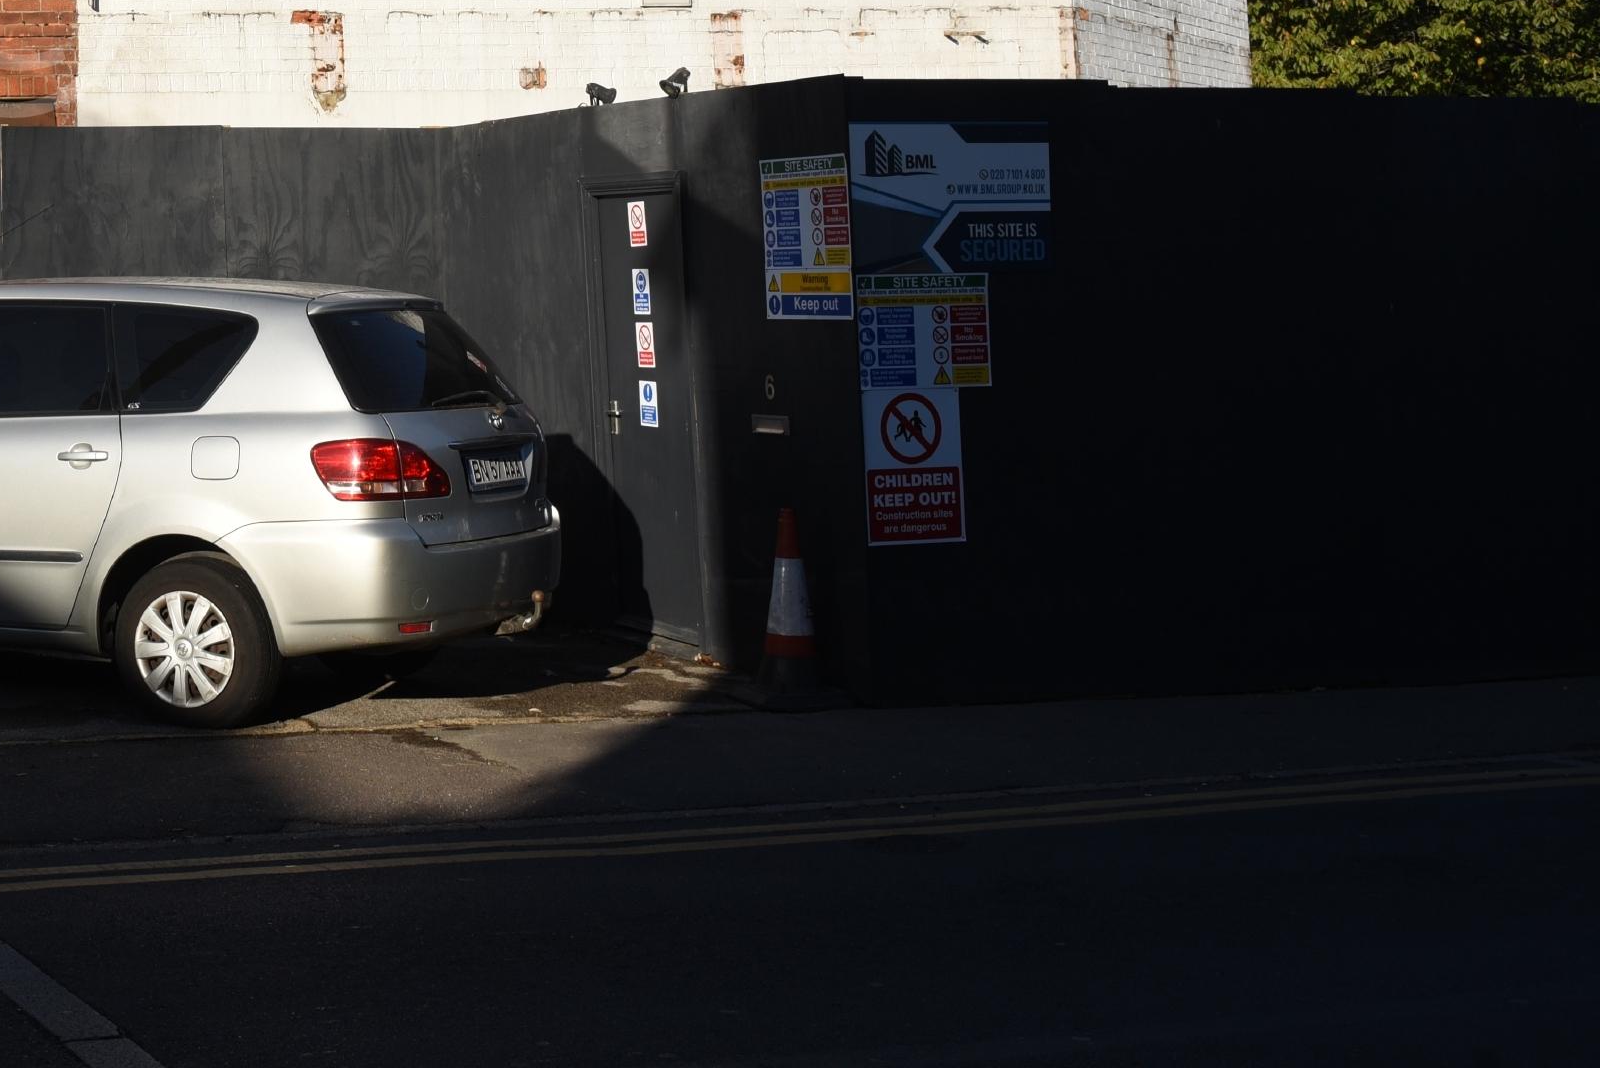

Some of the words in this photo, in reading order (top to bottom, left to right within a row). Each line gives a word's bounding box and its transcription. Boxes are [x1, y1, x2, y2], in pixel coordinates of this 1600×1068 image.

[785, 160, 801, 172] SITE
[803, 157, 833, 171] SAFETY
[905, 154, 937, 169] BML
[990, 168, 1005, 180] 020
[968, 223, 995, 238] THIS
[997, 223, 1024, 238] SITE
[1026, 223, 1038, 237] IS
[960, 238, 1046, 262] SECURED
[802, 273, 829, 285] Warning
[893, 276, 919, 288] SITE
[922, 275, 966, 288] SAFETY
[793, 296, 820, 314] Keep
[822, 297, 839, 311] out
[765, 374, 775, 400] 6
[874, 472, 954, 489] CHILDREN
[873, 493, 915, 508] KEEP
[919, 491, 957, 506] OUT!
[875, 511, 932, 521] Construction
[933, 509, 954, 519] sites
[884, 525, 899, 533] are
[900, 523, 947, 534] dangerous
